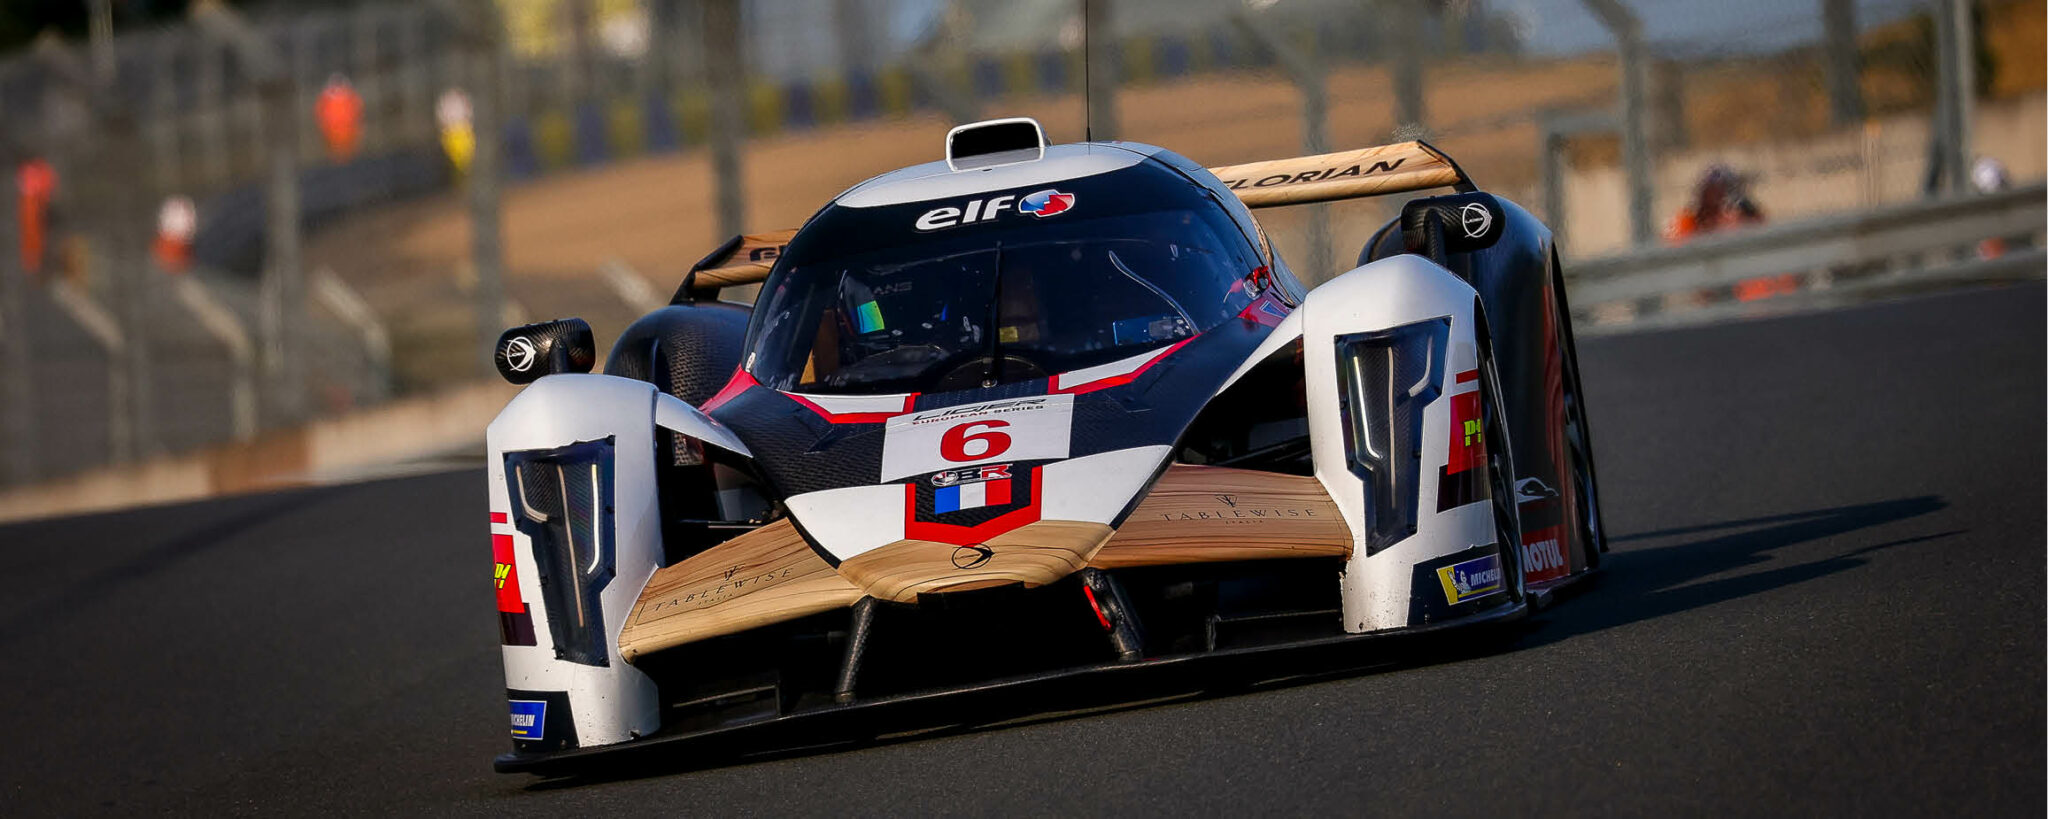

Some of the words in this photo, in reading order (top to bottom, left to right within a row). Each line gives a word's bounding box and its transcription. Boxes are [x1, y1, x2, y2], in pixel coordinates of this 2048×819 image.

[916, 195, 1016, 231] elf
[912, 410, 988, 425] EUROPEAN
[993, 404, 1044, 414] SERIES
[940, 419, 1012, 463] 6
[1161, 508, 1318, 522] TABLEWISE
[1522, 538, 1564, 574] MOTUL
[655, 567, 793, 611] TABLEWISE
